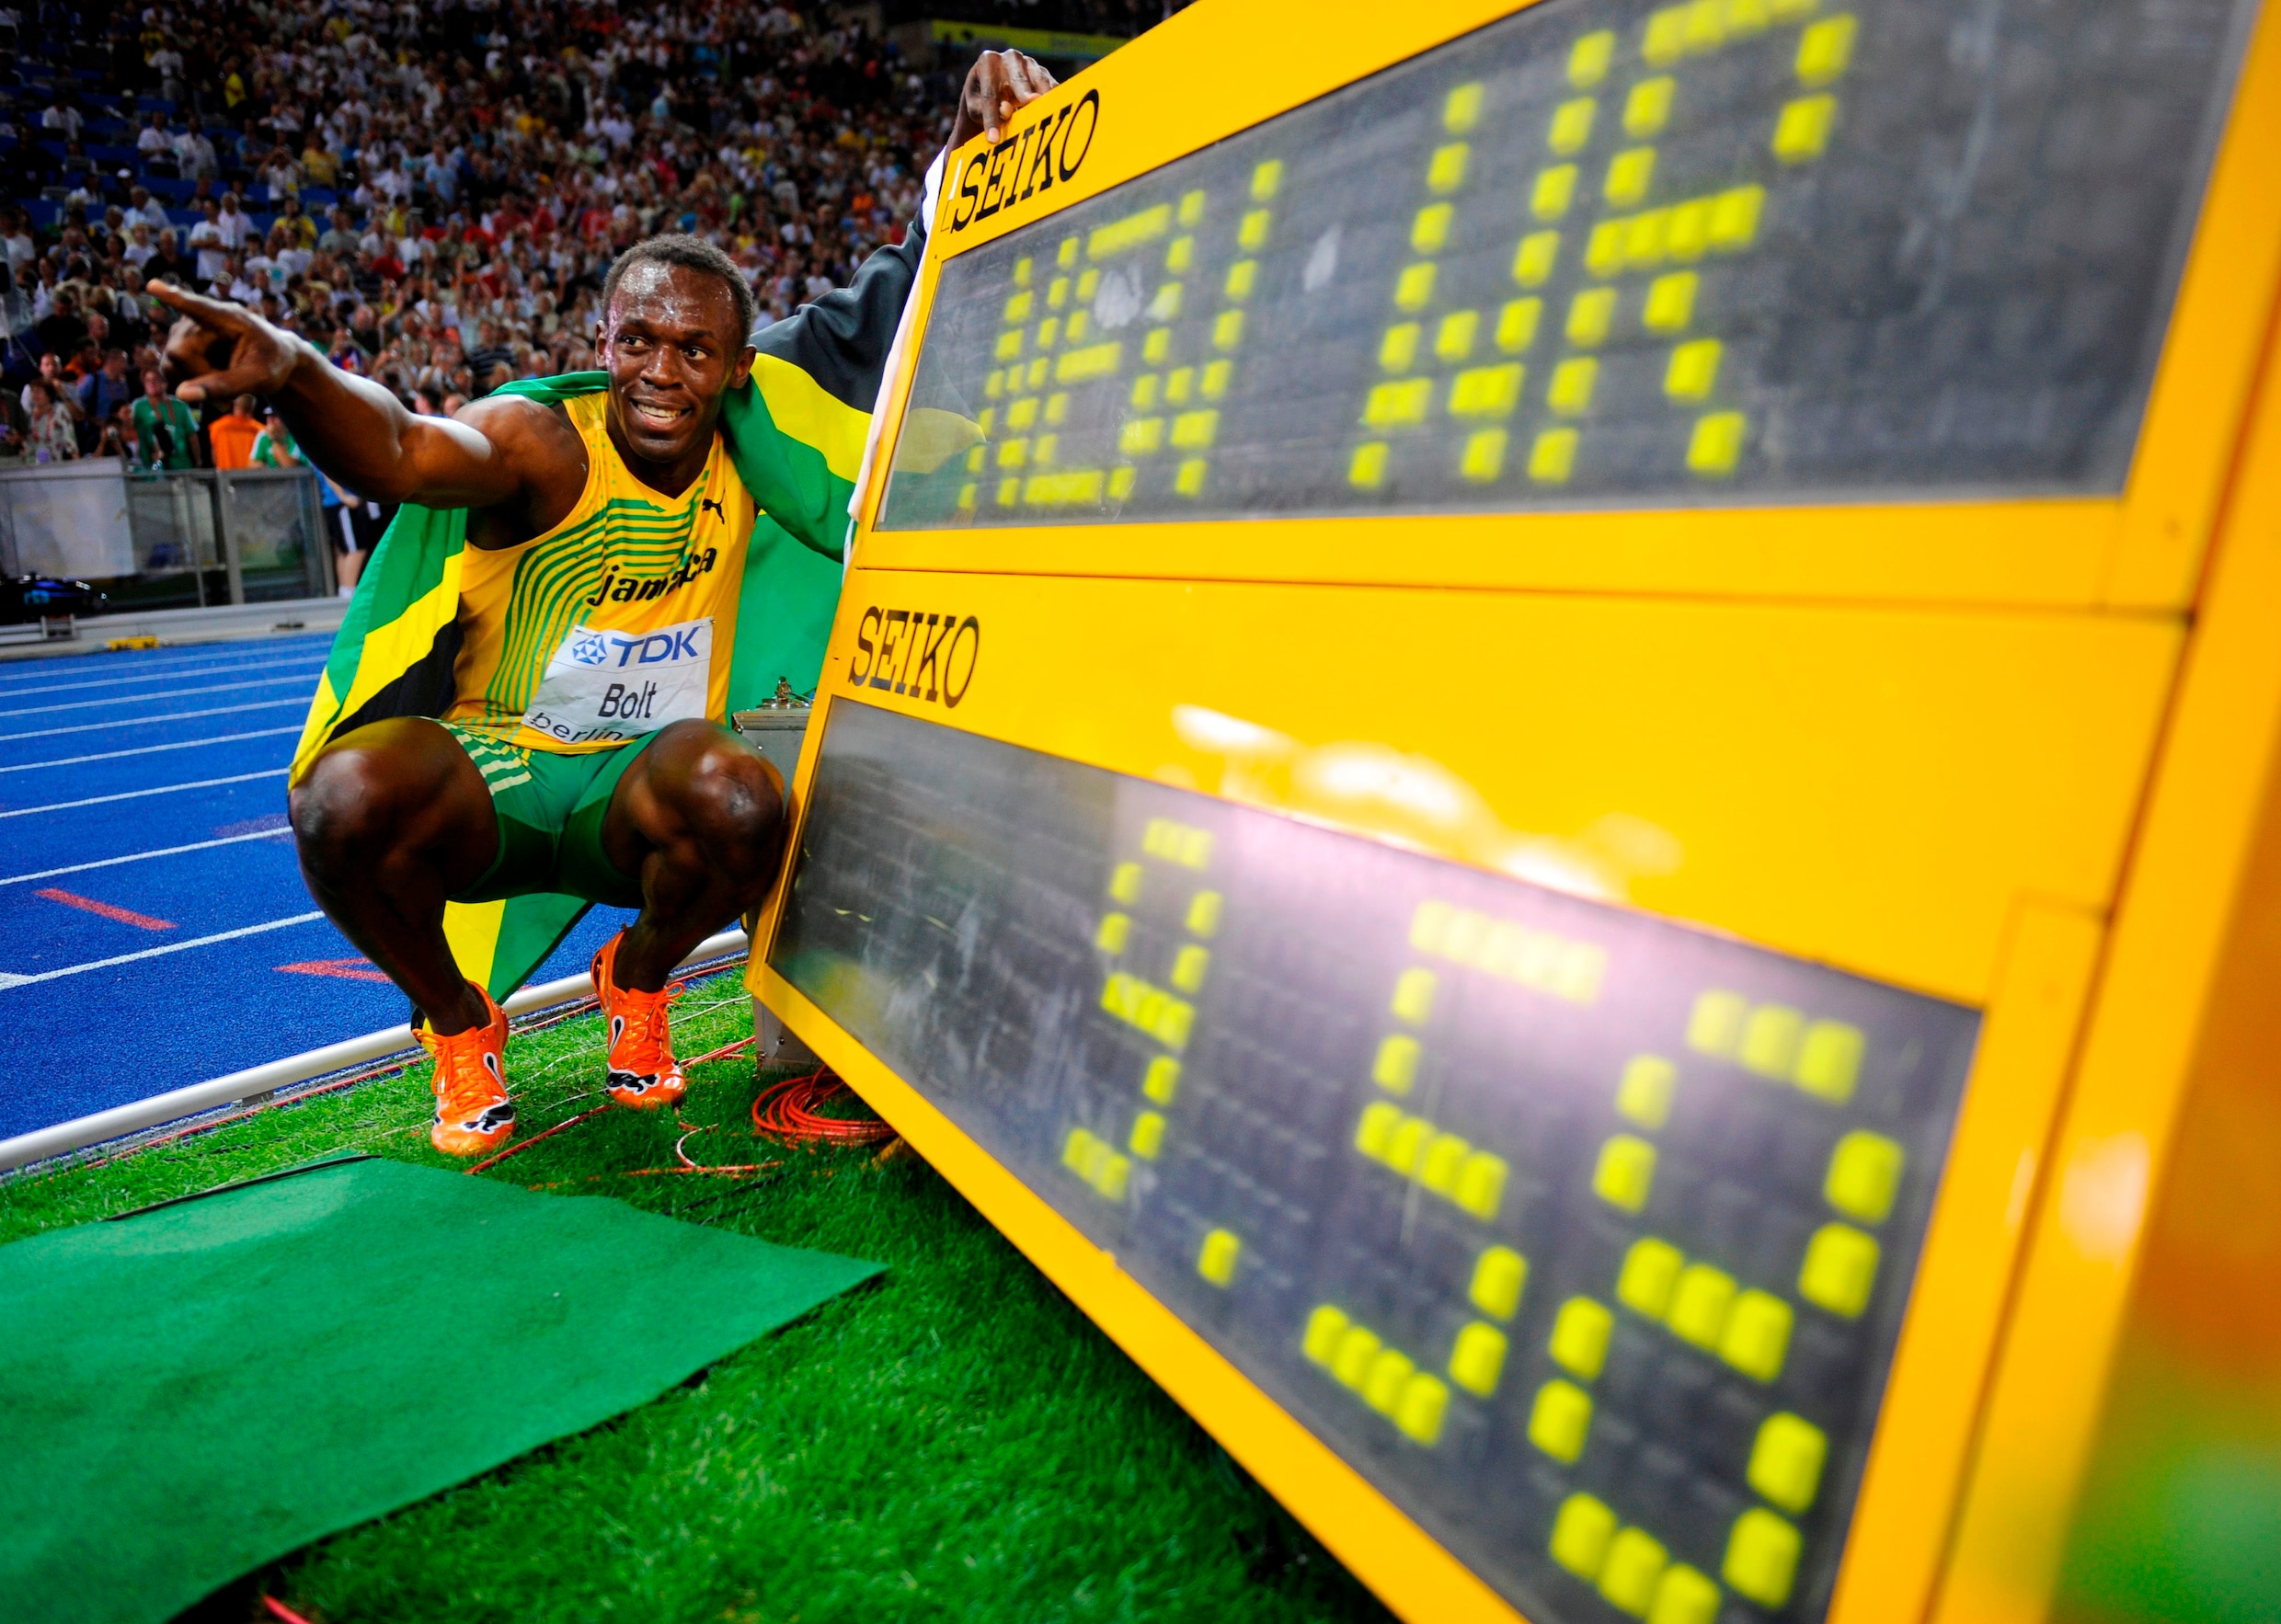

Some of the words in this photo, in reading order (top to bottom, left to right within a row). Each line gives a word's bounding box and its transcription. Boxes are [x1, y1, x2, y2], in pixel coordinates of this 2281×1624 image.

[951, 89, 1098, 234] SEIKO
[957, 160, 1281, 511] NEW
[1347, 0, 1858, 489] WR
[611, 626, 700, 667] TDK
[848, 605, 979, 708] SEIKO
[529, 712, 624, 741] berlin
[598, 680, 657, 719] Bolt
[1061, 818, 1903, 1624] 9.58
